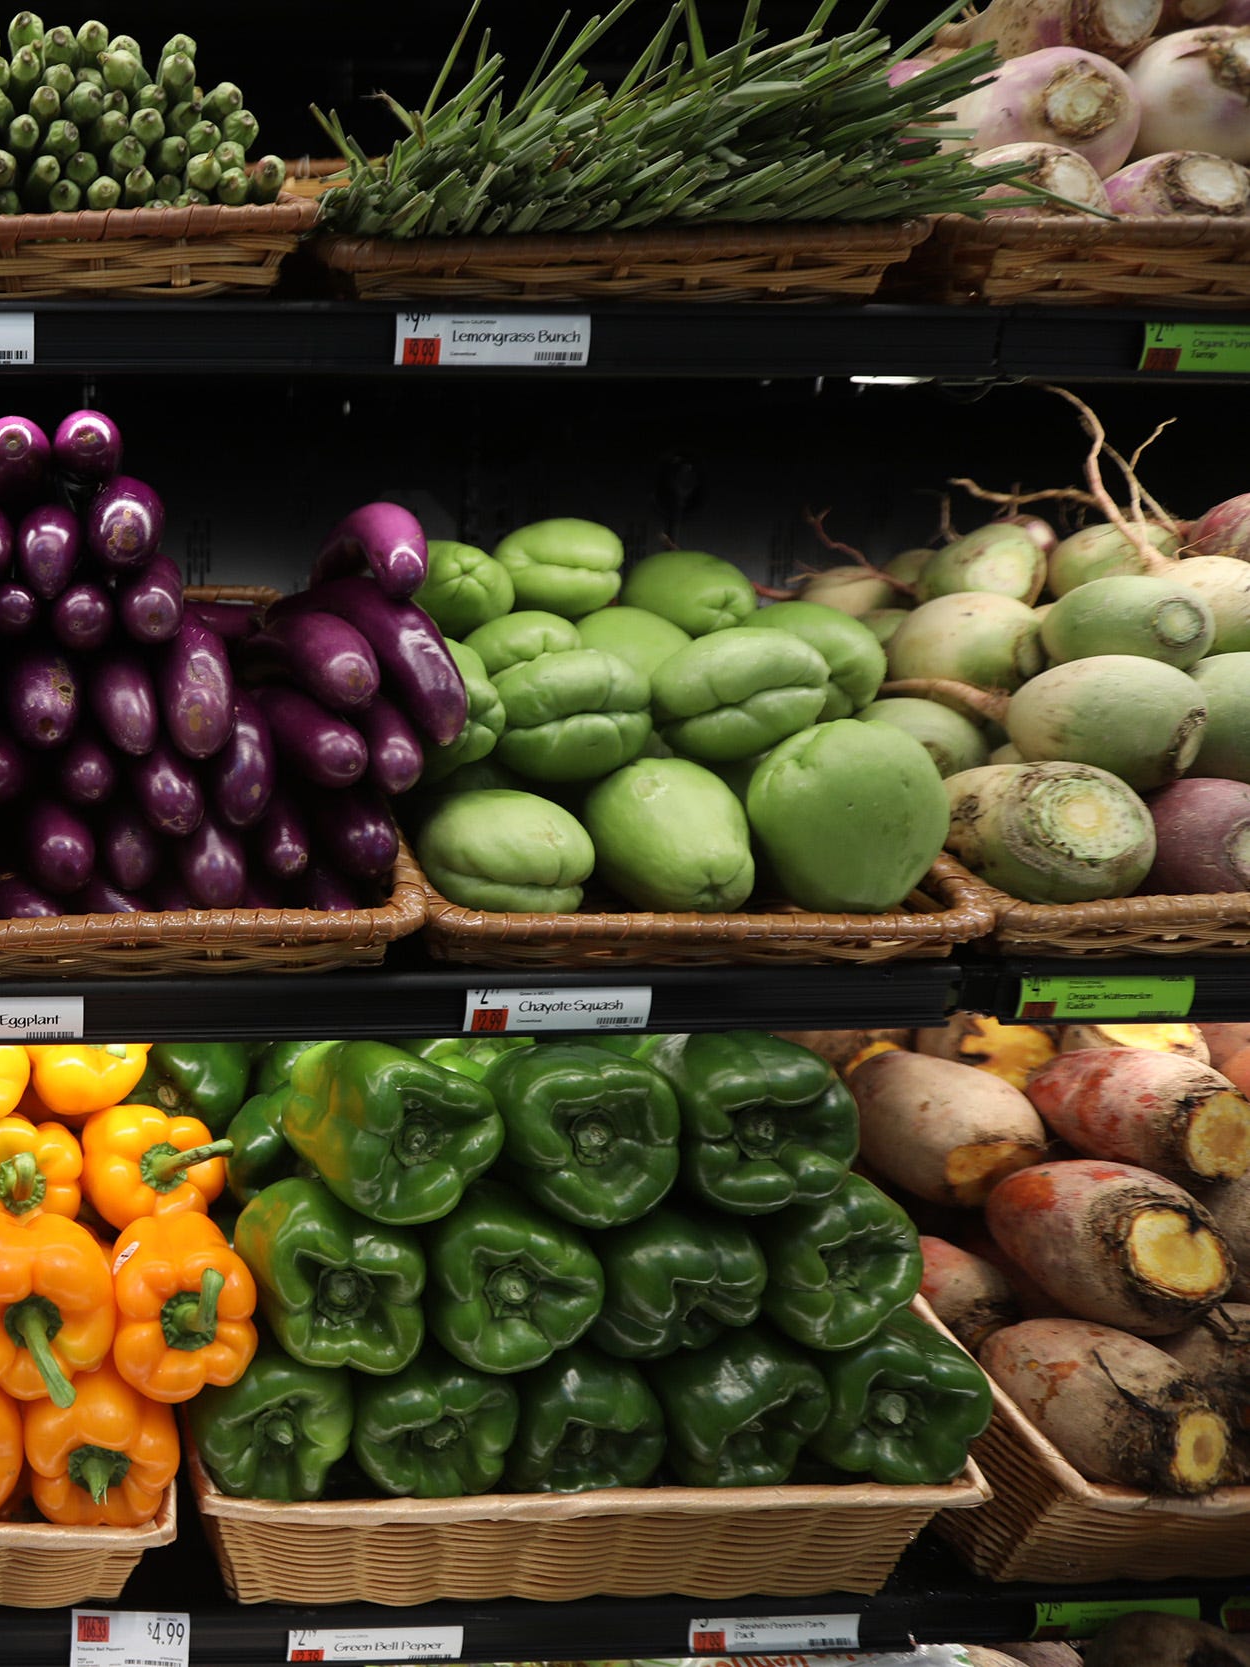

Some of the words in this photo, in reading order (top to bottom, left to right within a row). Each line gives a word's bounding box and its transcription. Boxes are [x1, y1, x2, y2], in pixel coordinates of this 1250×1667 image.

[452, 330, 536, 347] Lemongrass
[538, 330, 581, 343] Bunch
[518, 1000, 572, 1015] Chayote
[574, 999, 624, 1013] Squash
[0, 1014, 61, 1029] Eggplant
[147, 1622, 185, 1646] $4.99
[334, 1642, 372, 1652] Green
[375, 1641, 399, 1651] Bell
[401, 1640, 445, 1651] Pepper
